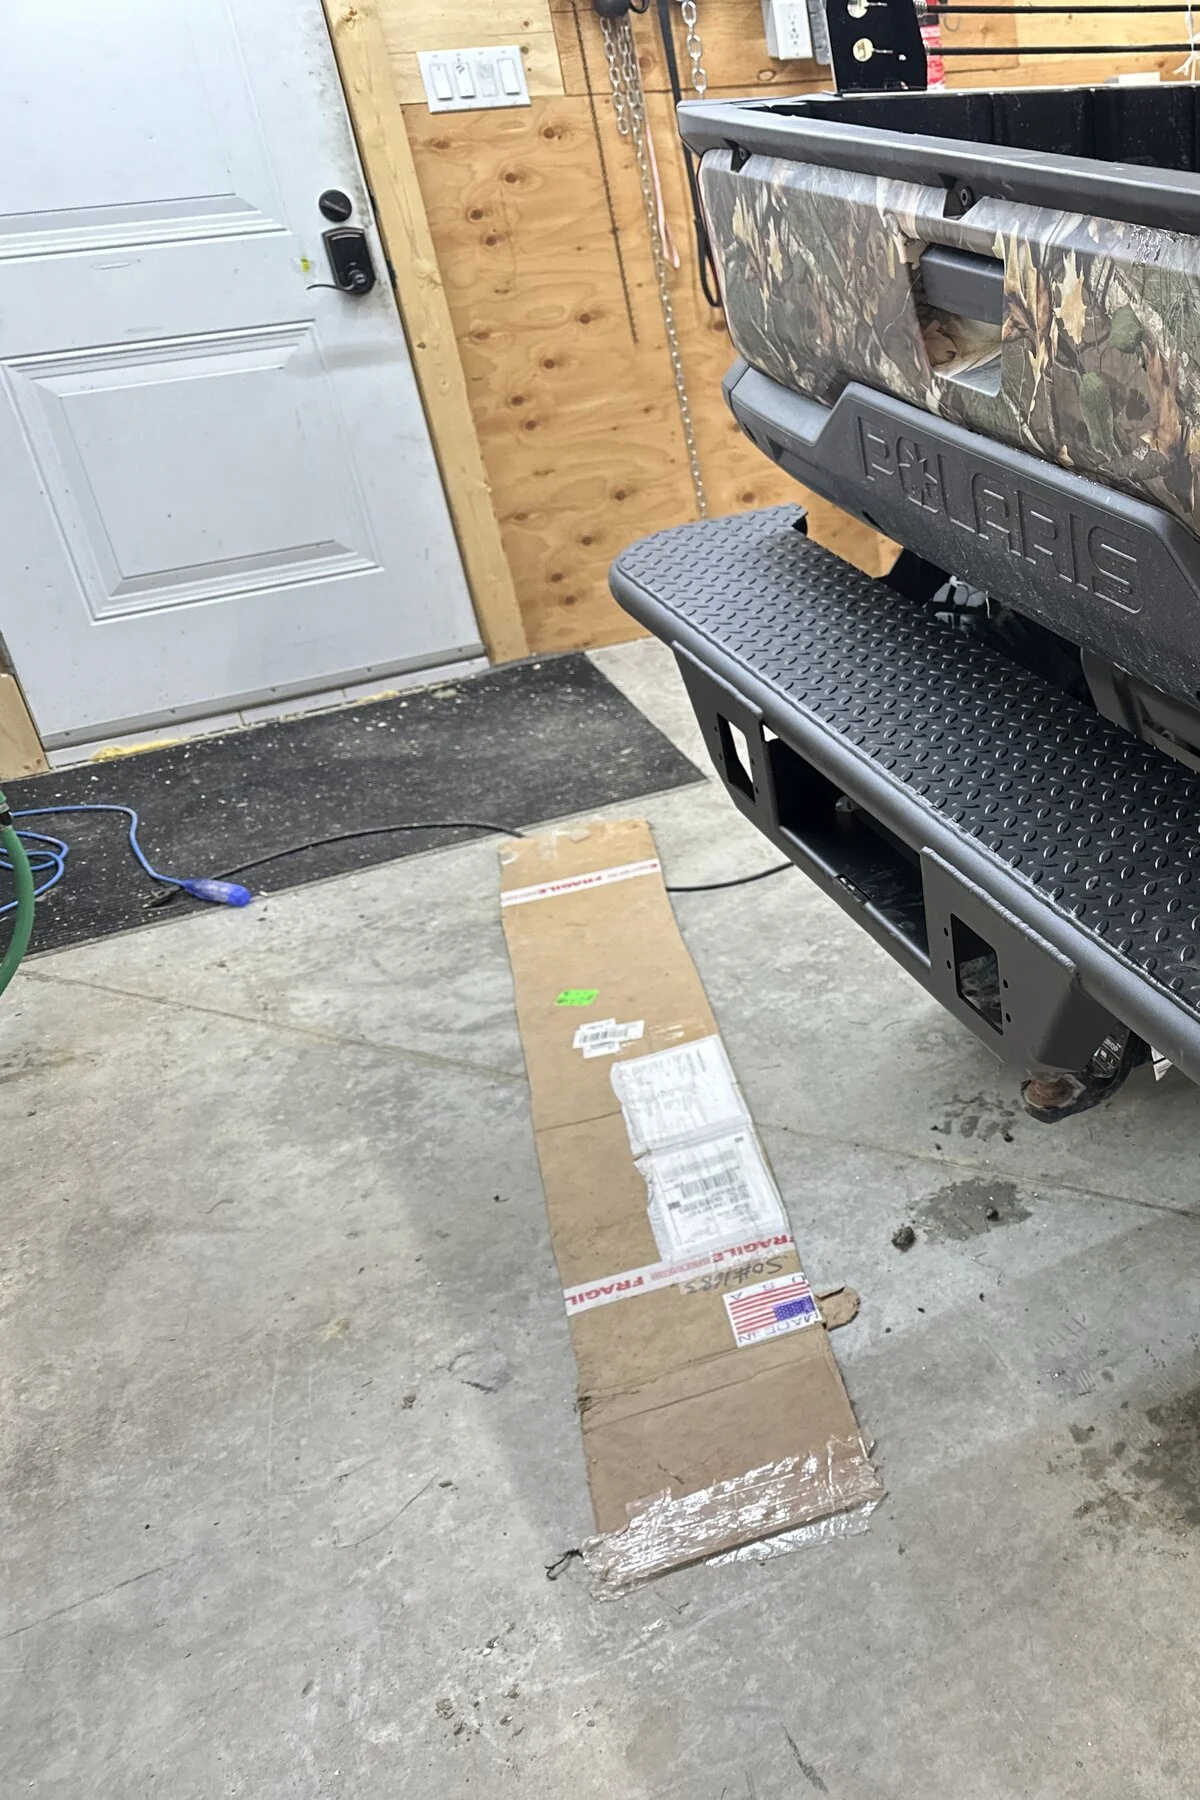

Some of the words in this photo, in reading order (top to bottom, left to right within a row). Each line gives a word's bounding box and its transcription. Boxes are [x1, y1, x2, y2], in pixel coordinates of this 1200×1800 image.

[857, 415, 1143, 614] POLARIS
[766, 1312, 819, 1335] MADE
[738, 1332, 757, 1344] IN
